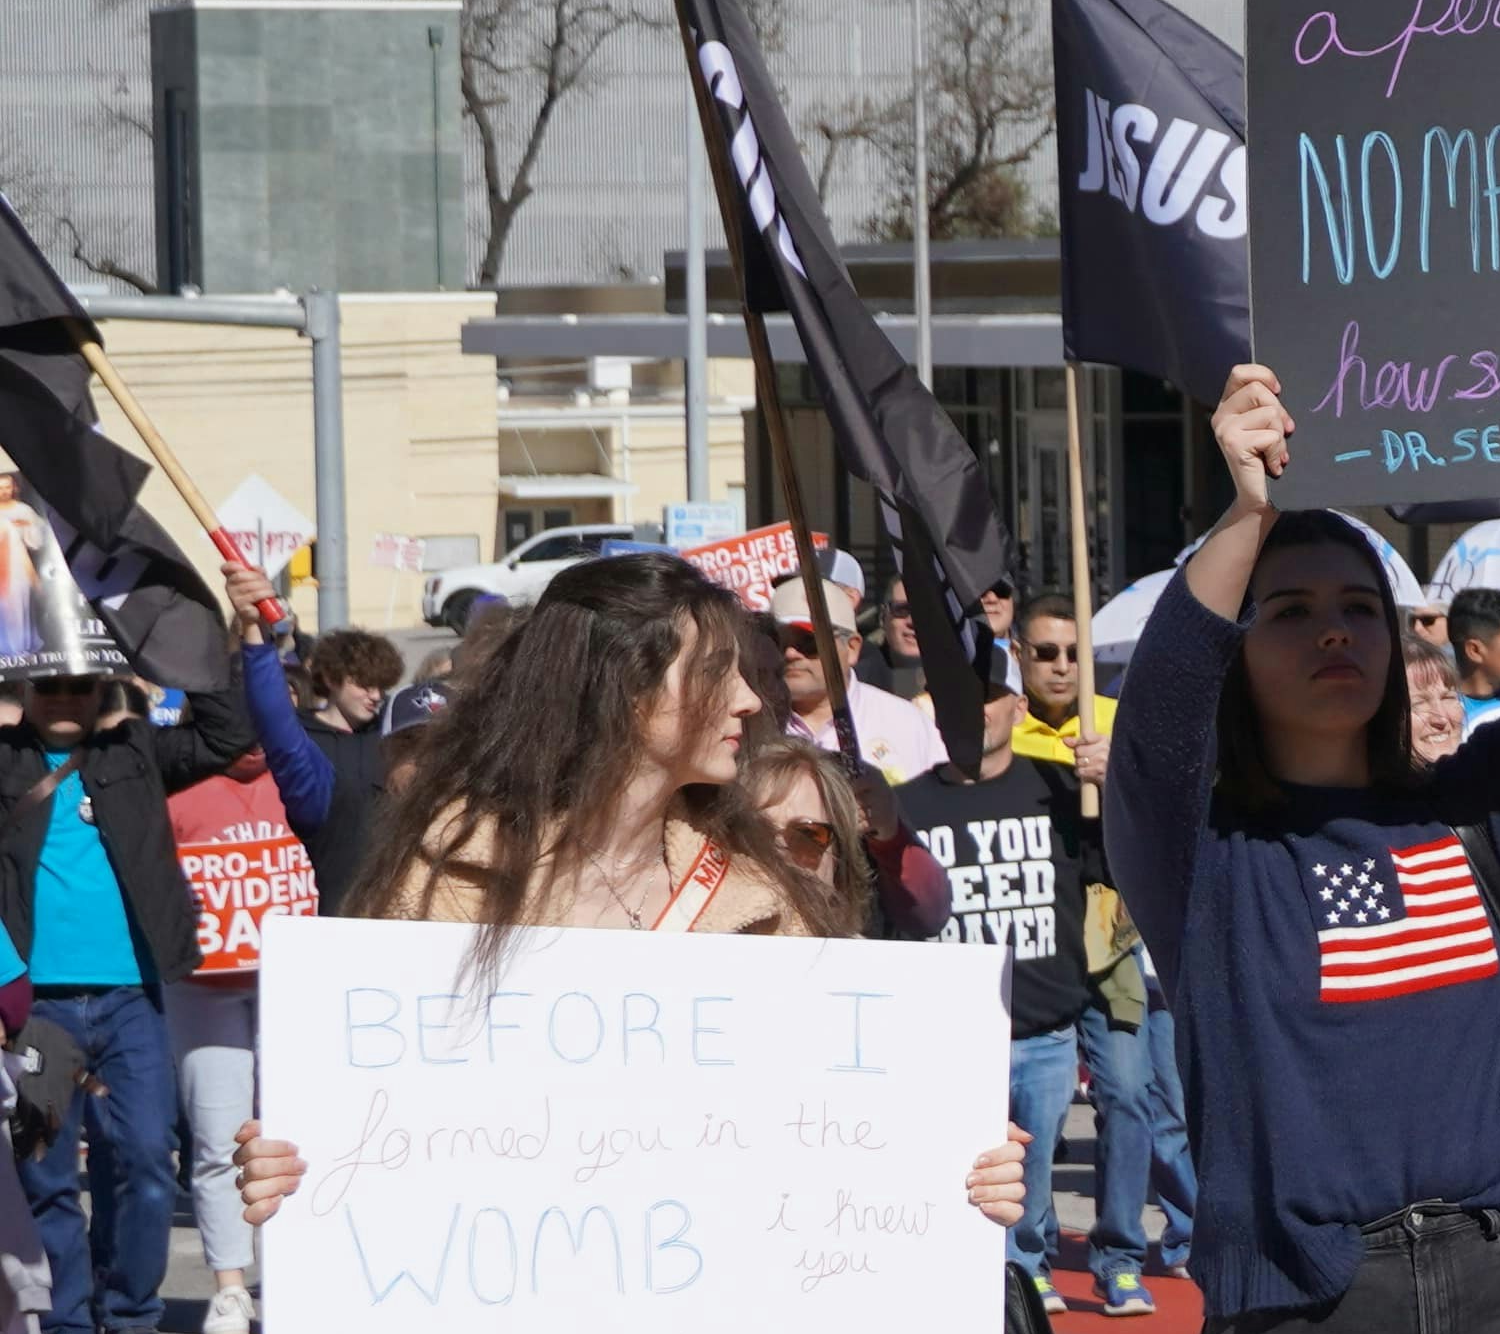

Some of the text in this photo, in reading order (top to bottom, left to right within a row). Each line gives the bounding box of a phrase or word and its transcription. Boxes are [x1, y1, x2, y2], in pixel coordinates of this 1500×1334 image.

[1293, 11, 1390, 65] a
[1298, 129, 1404, 286] NO
[1311, 319, 1457, 420] how
[968, 816, 1052, 864] YOU
[948, 860, 1056, 914] EED
[926, 906, 1056, 960] RAYER
[343, 988, 894, 1074] BEFORE I
[311, 1089, 887, 1216] formed you in the
[343, 1199, 703, 1307] WOMB
[794, 1247, 878, 1292] you
